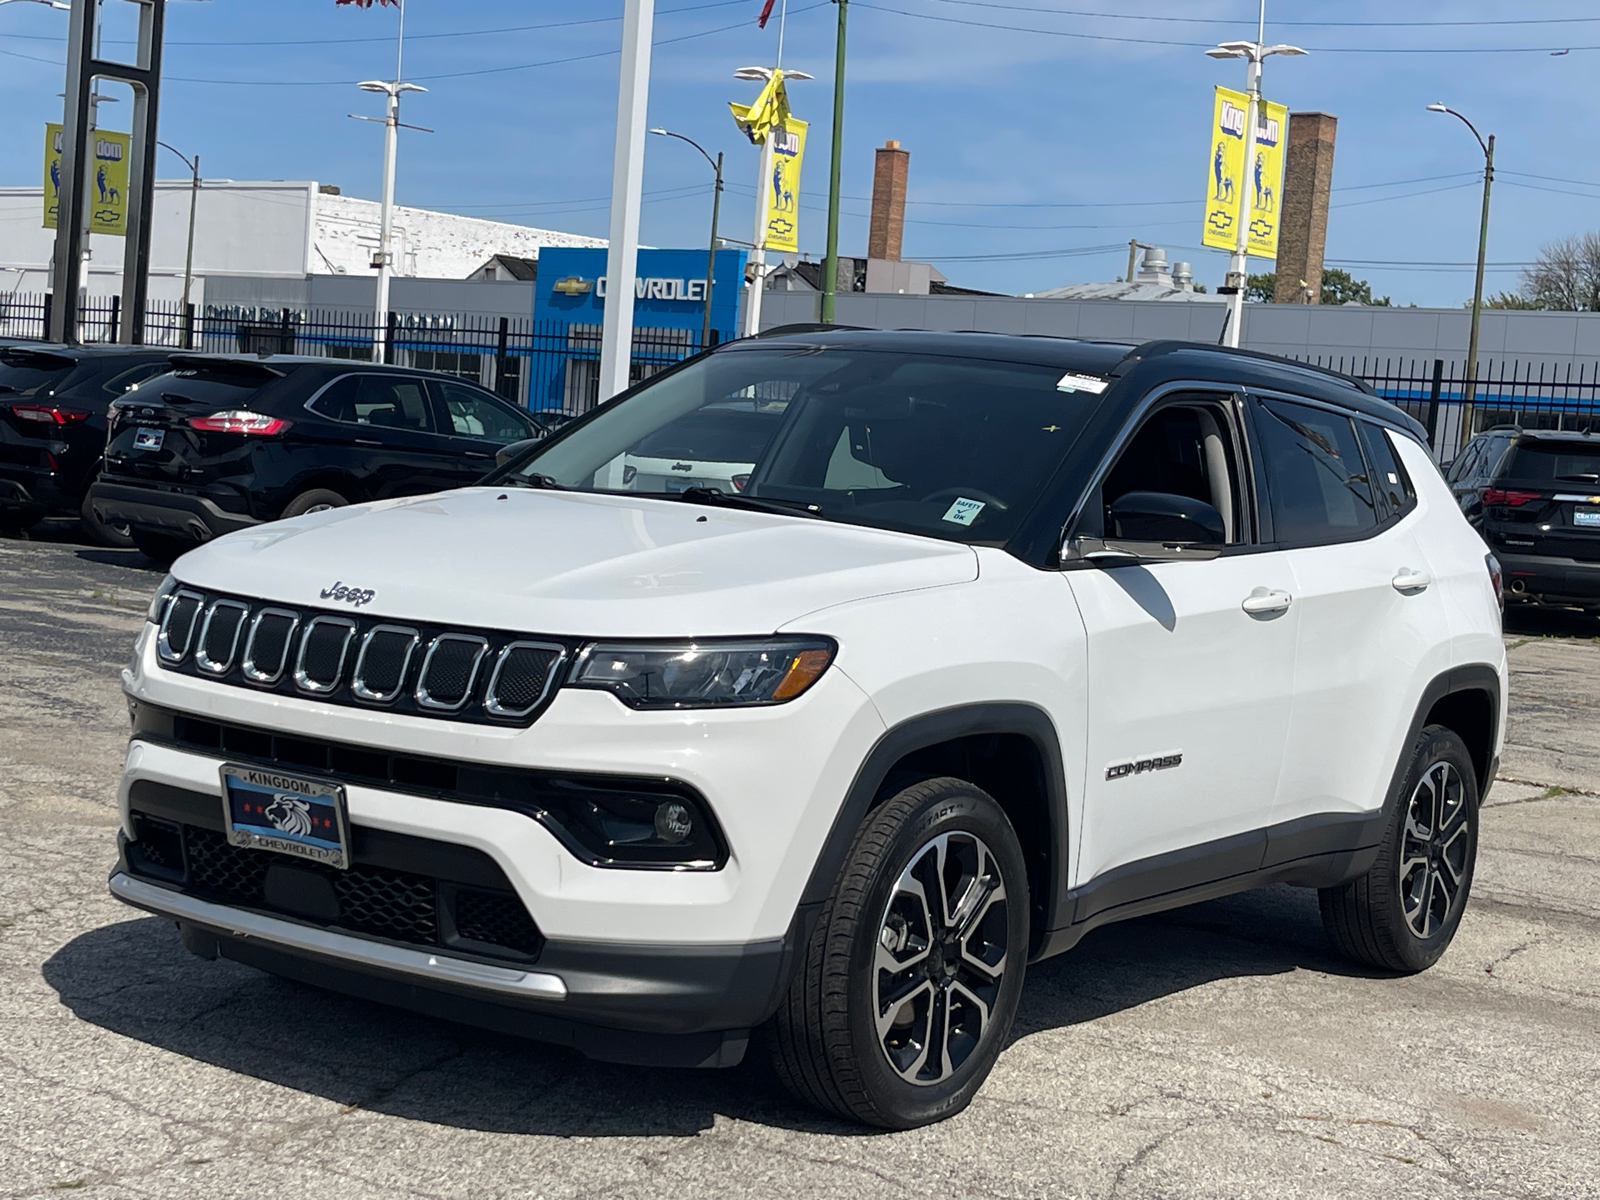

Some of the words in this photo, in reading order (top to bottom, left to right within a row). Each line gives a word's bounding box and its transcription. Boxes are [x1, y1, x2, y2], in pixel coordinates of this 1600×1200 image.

[1219, 100, 1245, 138] King
[96, 138, 122, 160] dom
[596, 276, 716, 301] CVROLET
[956, 500, 981, 510] SAFETY
[320, 581, 376, 607] Jeep
[1105, 753, 1183, 781] COMPASS
[249, 771, 311, 795] KINGDOM
[259, 838, 324, 859] CHEVROLET
